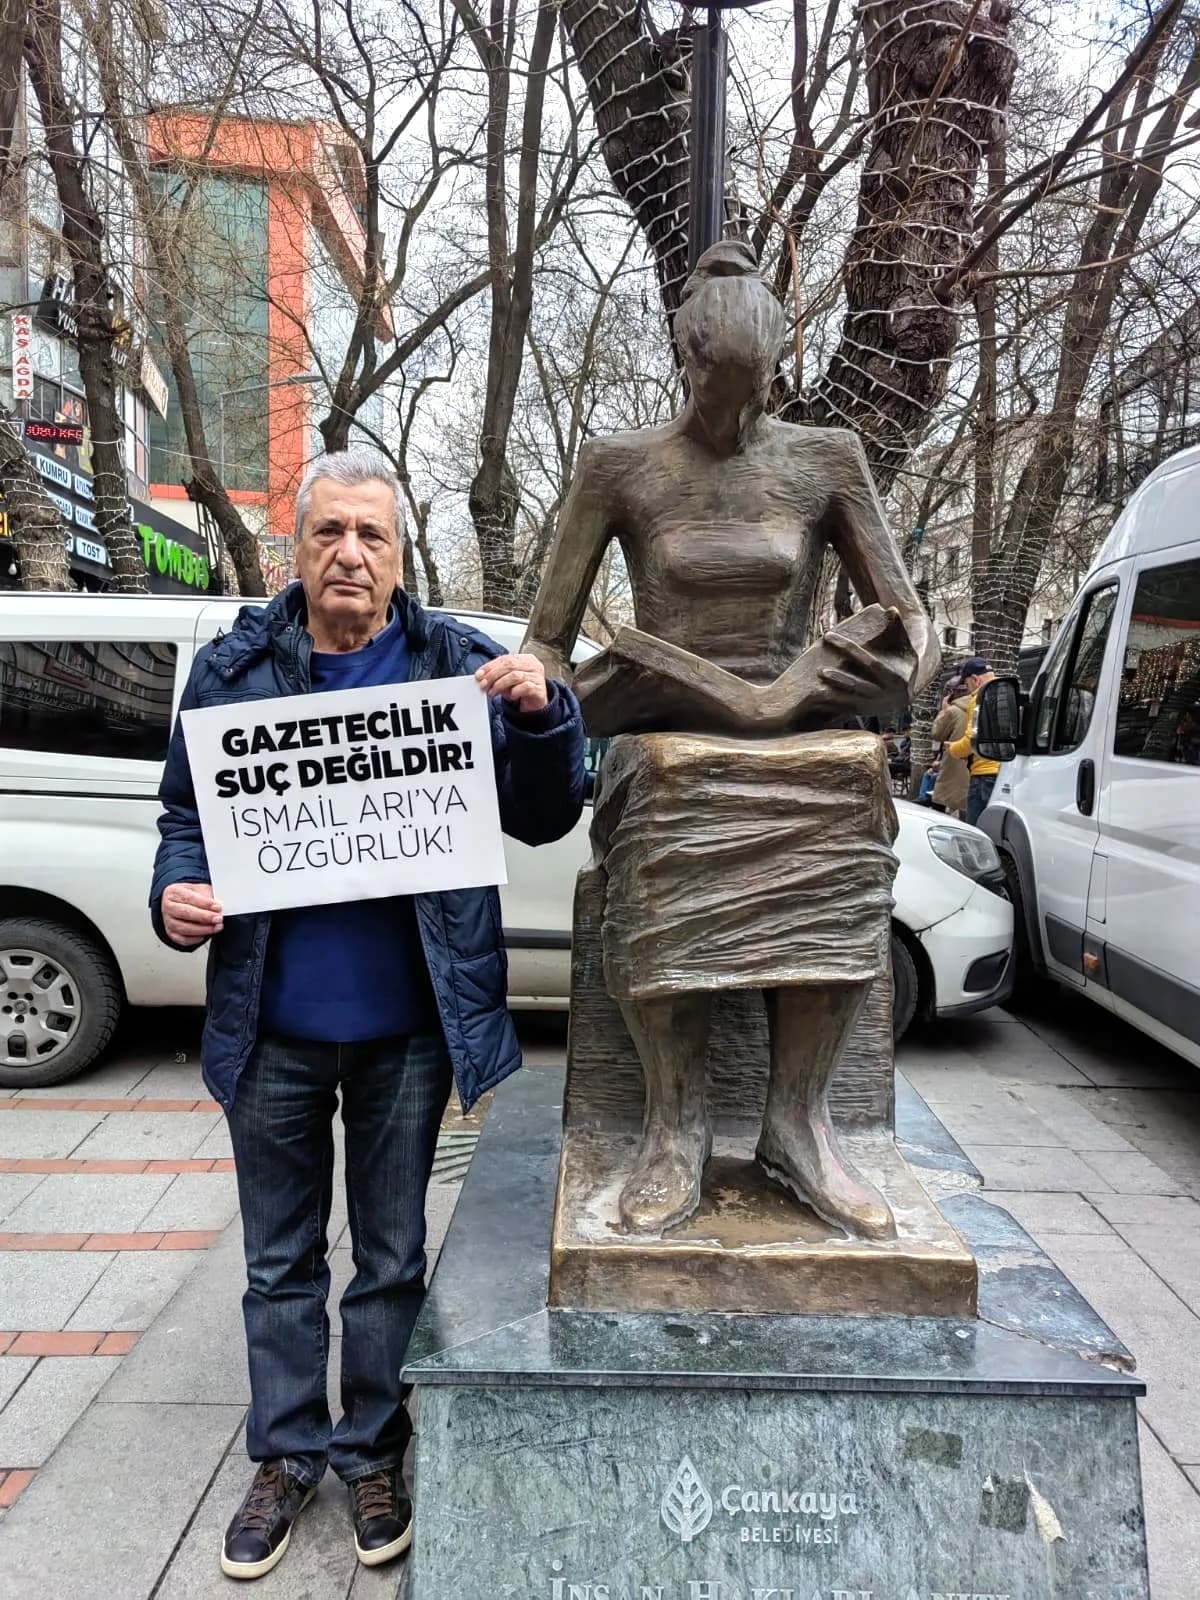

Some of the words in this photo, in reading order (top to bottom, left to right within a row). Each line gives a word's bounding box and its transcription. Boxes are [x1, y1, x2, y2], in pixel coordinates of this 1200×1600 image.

[39, 458, 69, 484] KUMRU
[82, 541, 100, 558] TOST
[222, 699, 459, 757] GAZETECİLİK
[215, 762, 291, 798] SUÇ
[297, 738, 474, 788] DEĞİLDİR!
[230, 795, 348, 839] İSMAİL
[258, 825, 454, 874] ÖZGÜRLÜK!
[721, 1484, 859, 1520] Çankaya
[740, 1524, 839, 1545] BELEDİYESİ
